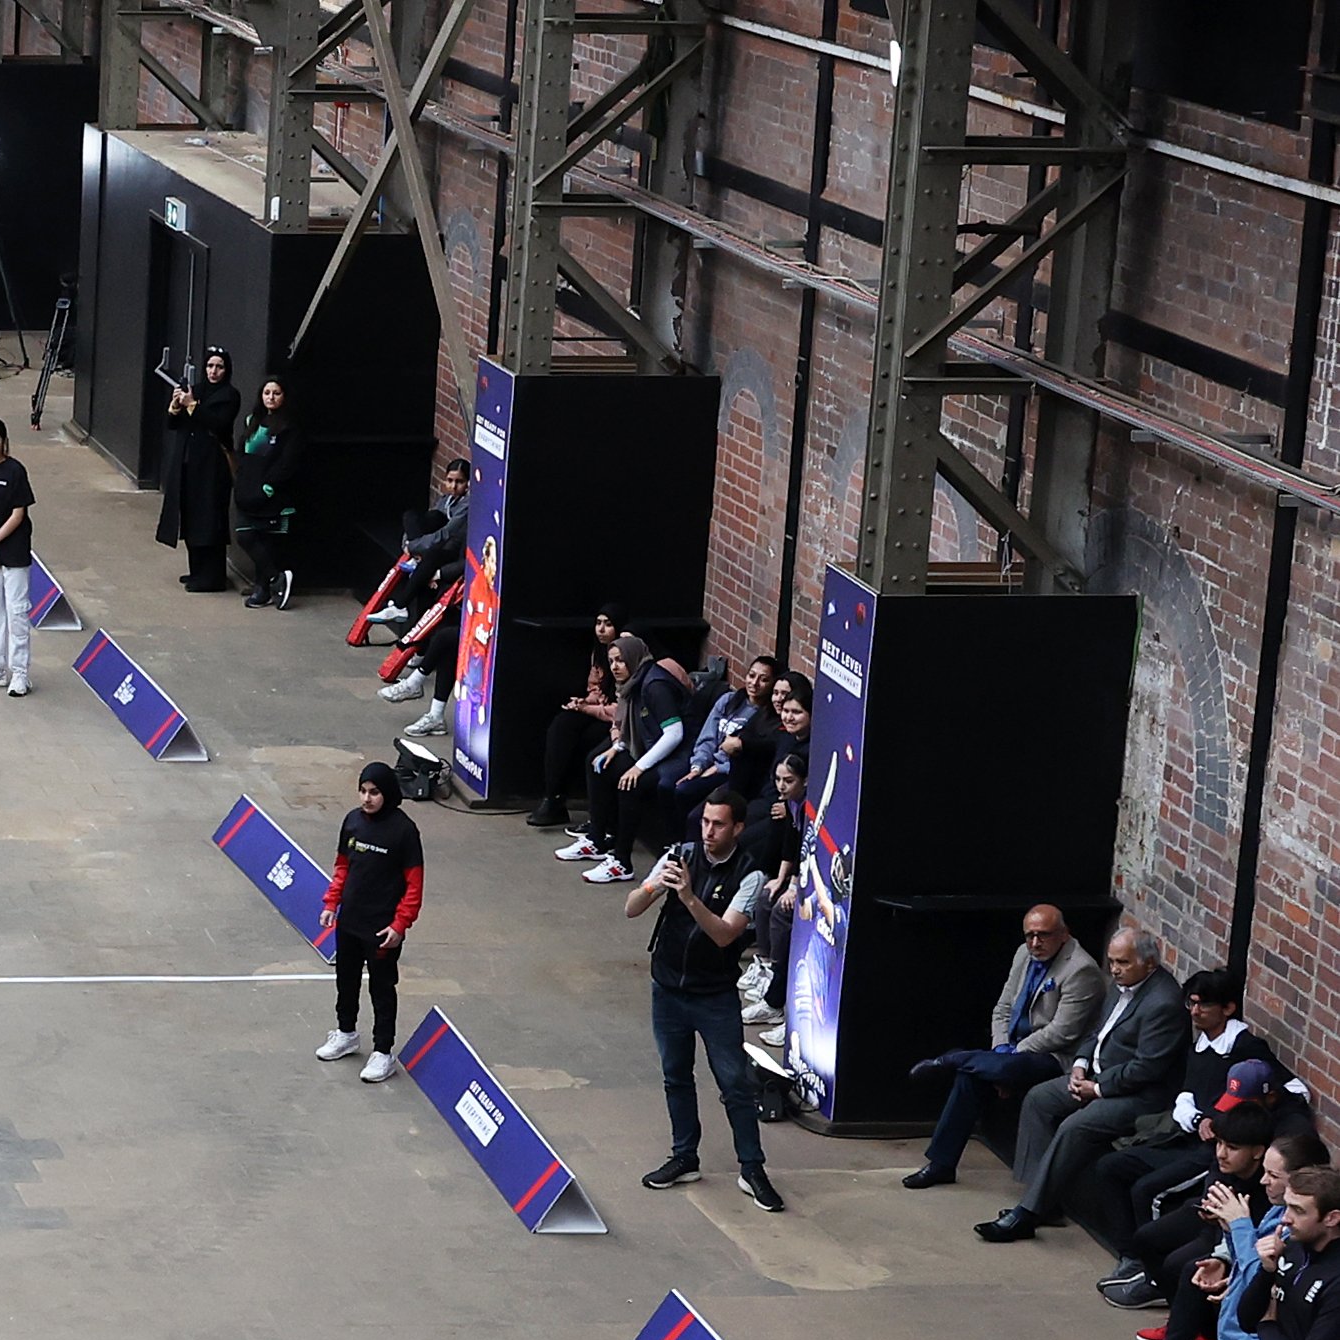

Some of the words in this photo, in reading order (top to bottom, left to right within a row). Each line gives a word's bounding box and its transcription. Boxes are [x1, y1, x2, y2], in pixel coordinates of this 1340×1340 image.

[822, 637, 841, 660] NEXT
[841, 651, 863, 677] LEVEL
[469, 1080, 481, 1095] GET
[478, 1091, 496, 1113] READY
[492, 1108, 505, 1126] FOR
